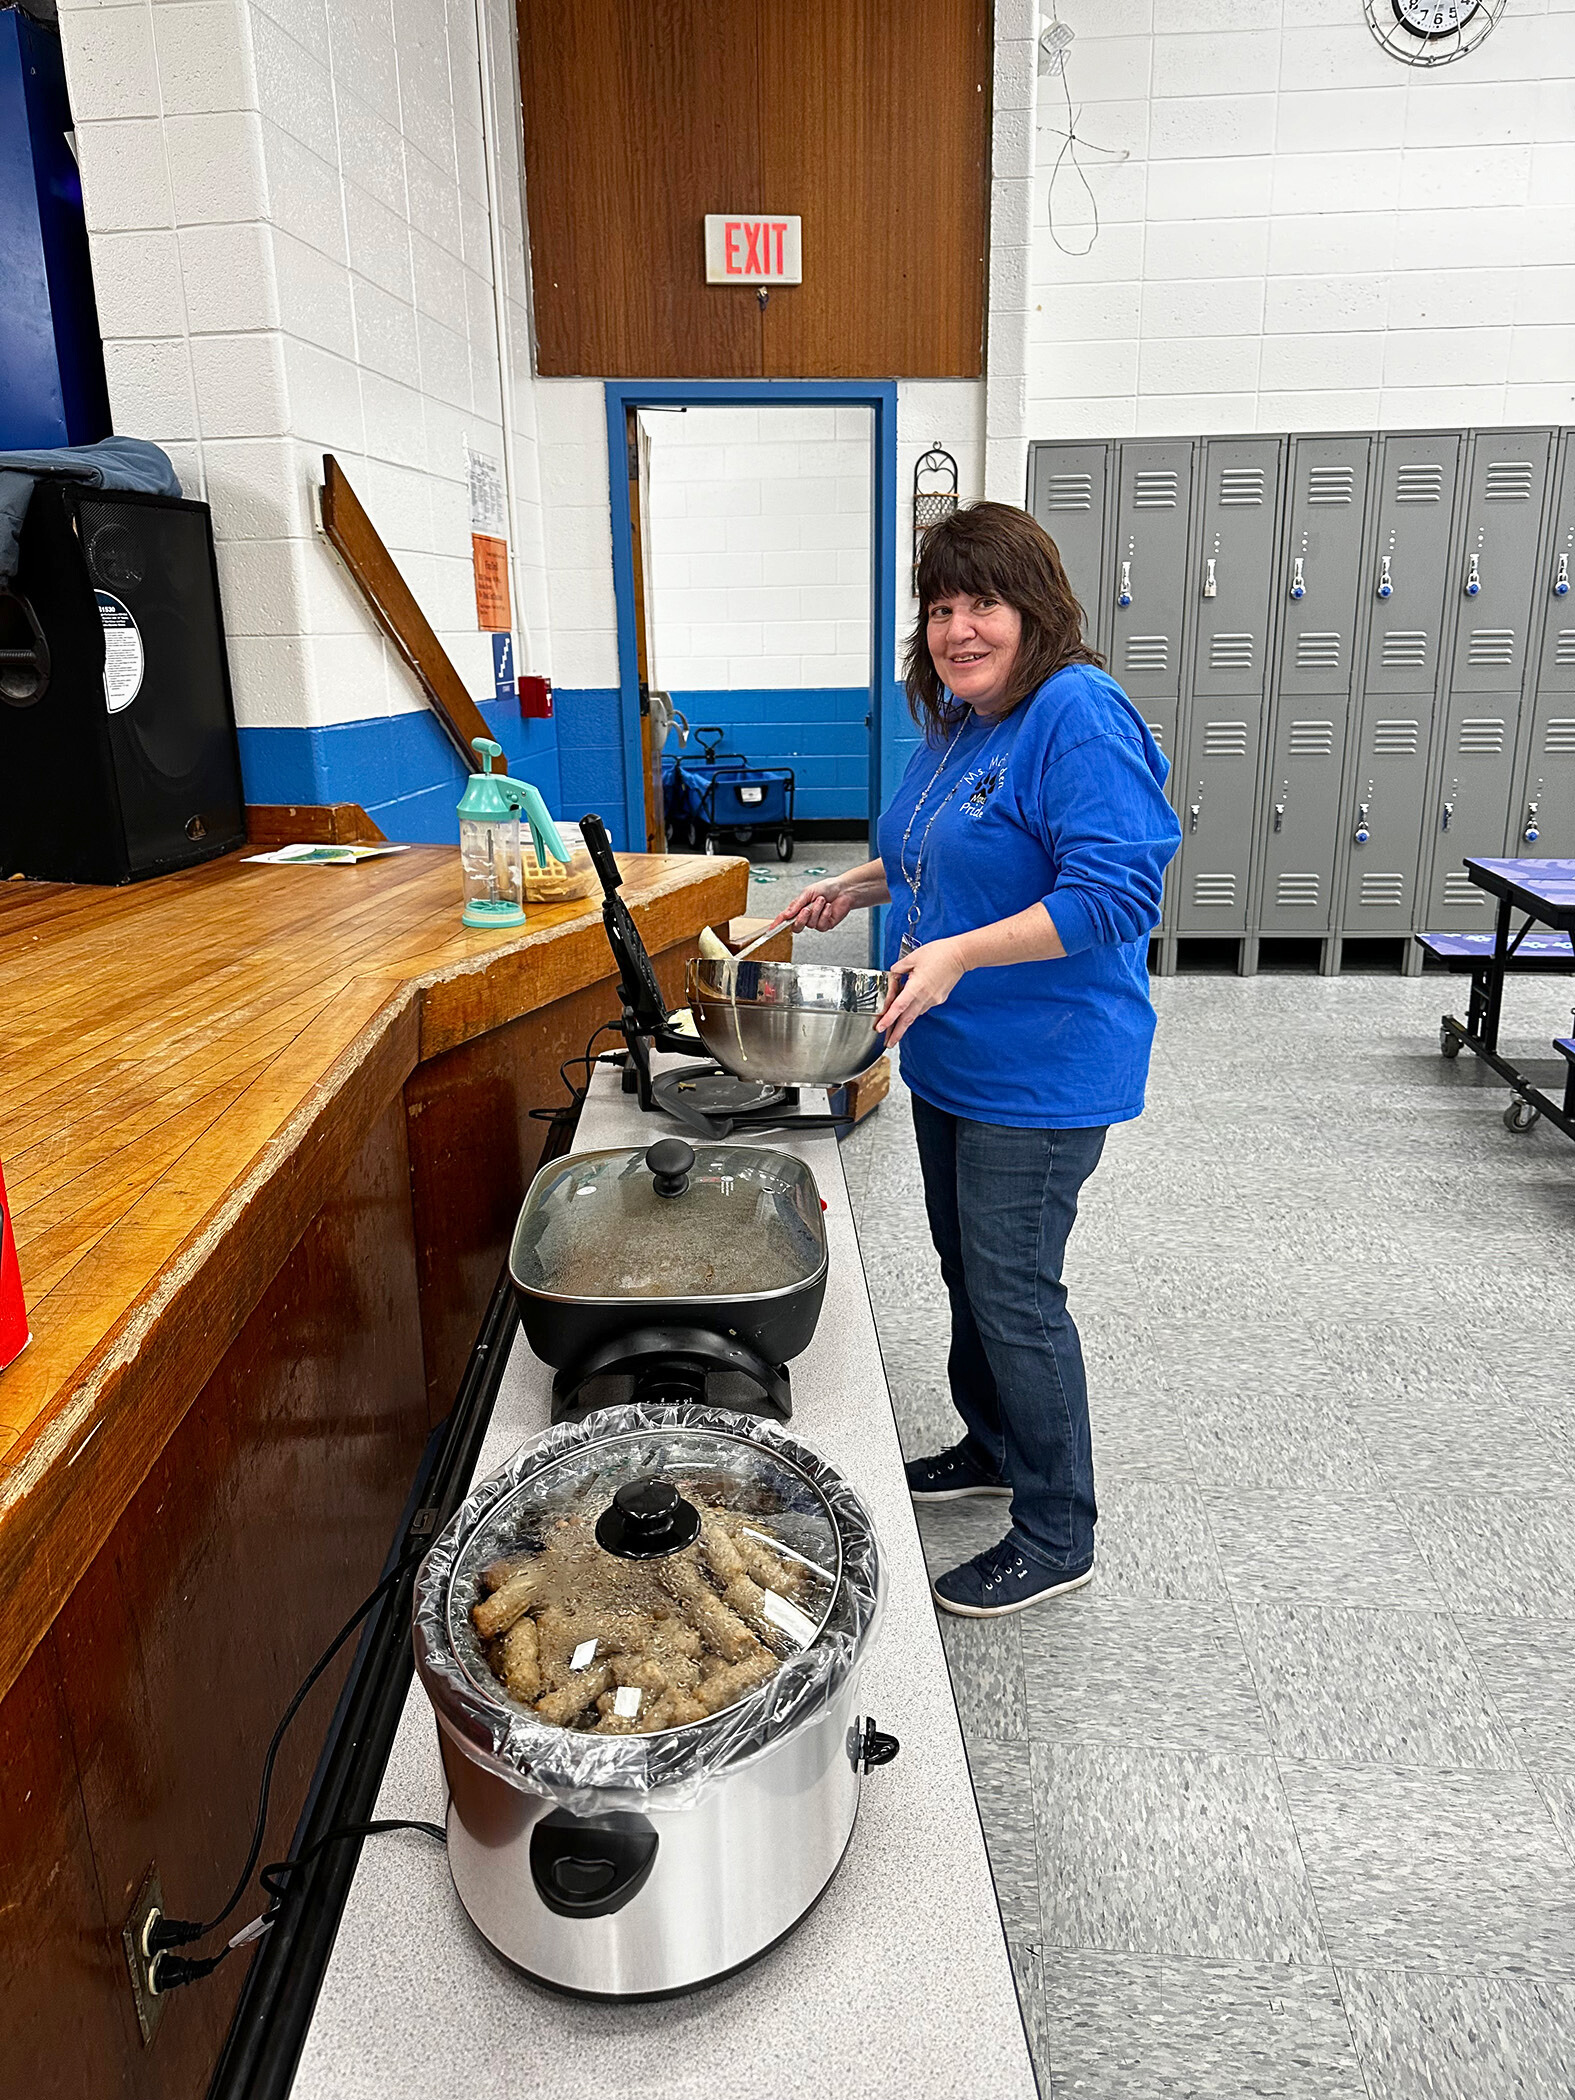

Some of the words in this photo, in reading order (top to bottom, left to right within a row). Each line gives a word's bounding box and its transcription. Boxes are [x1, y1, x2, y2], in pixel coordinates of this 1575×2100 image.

[1420, 9, 1429, 21] 7
[1433, 12, 1443, 25] 6
[1449, 7, 1458, 19] 5
[725, 222, 788, 275] EXIT
[959, 802, 984, 818] Pride
